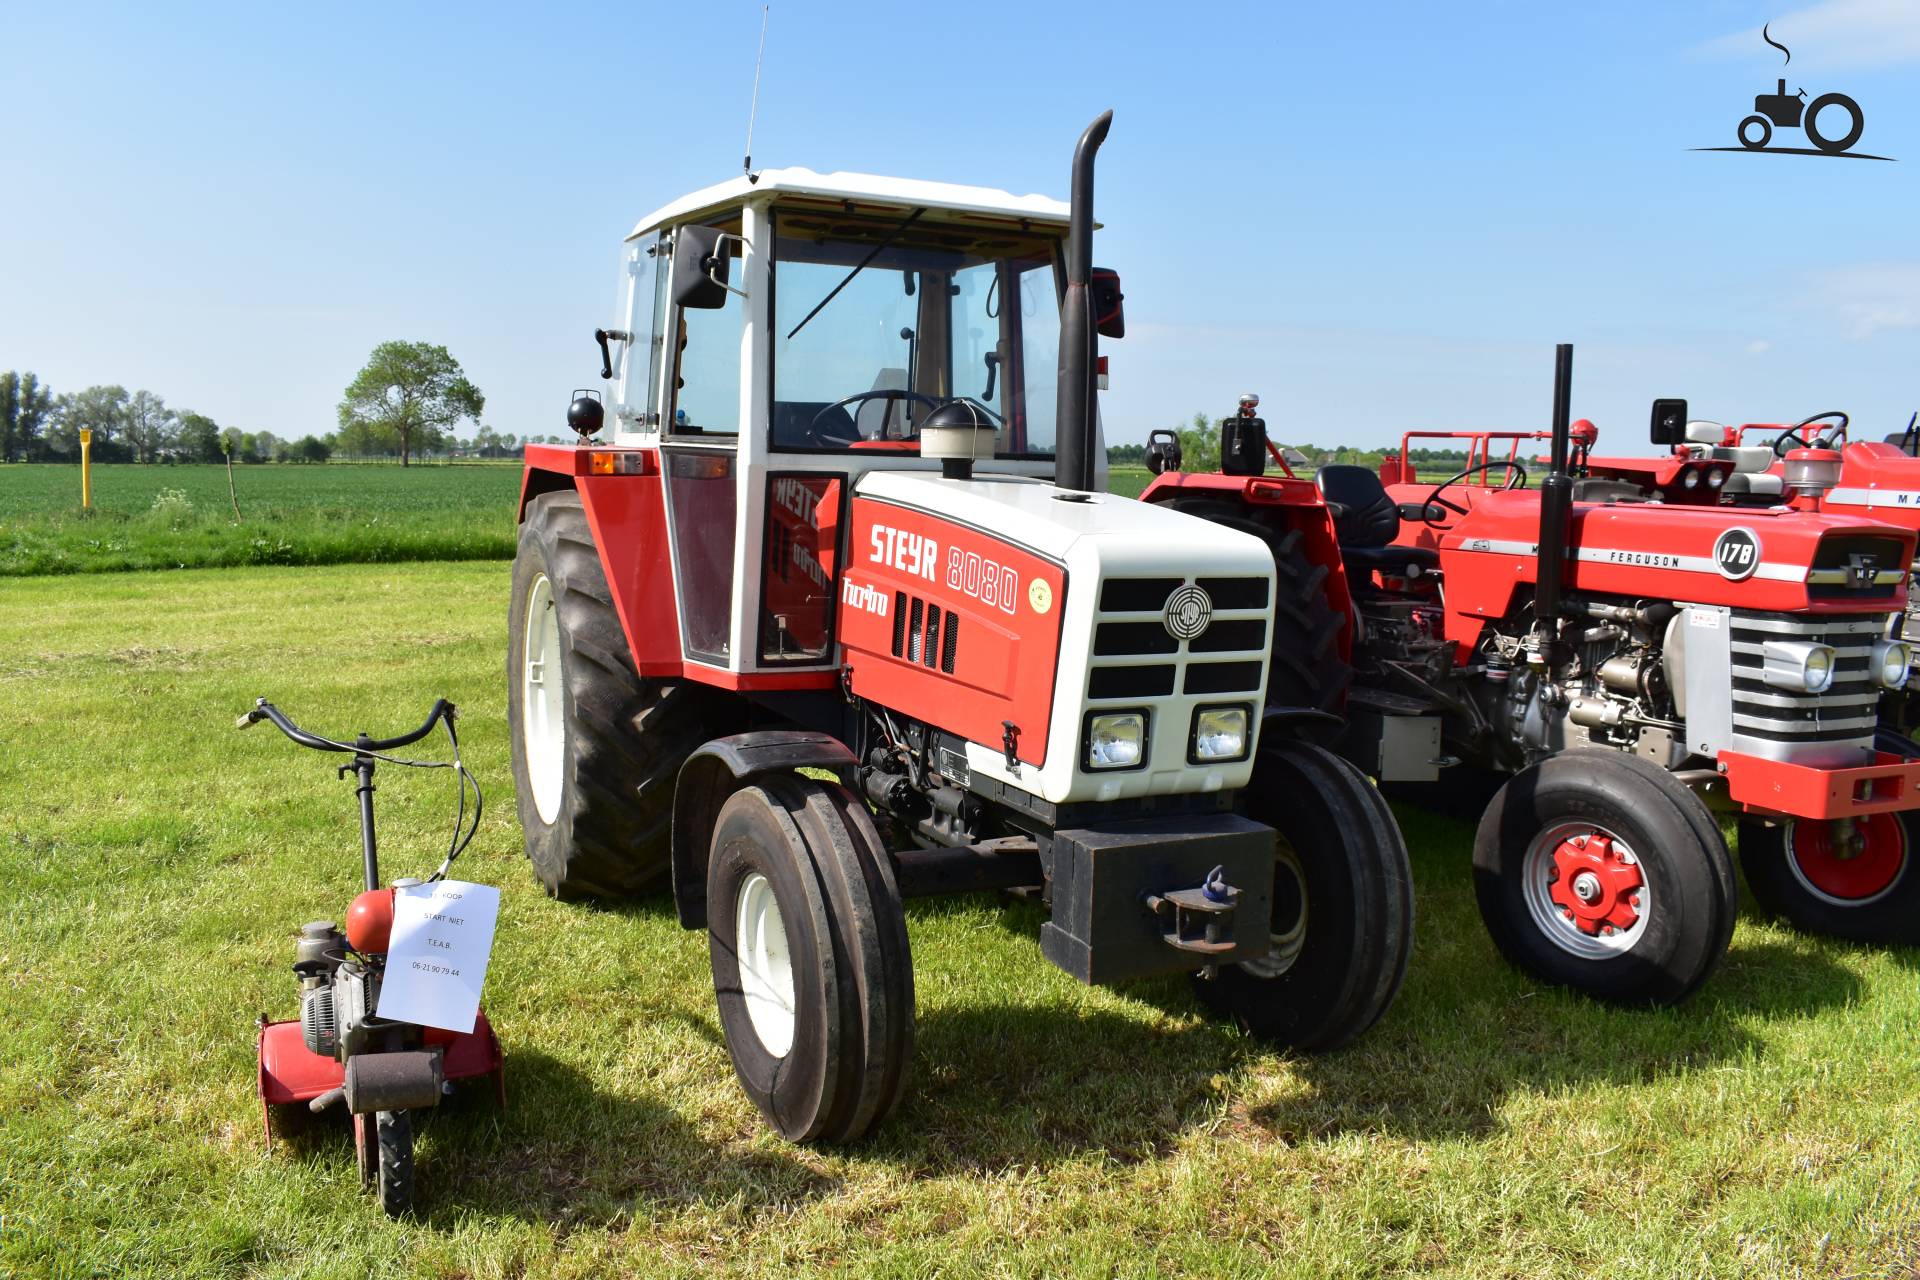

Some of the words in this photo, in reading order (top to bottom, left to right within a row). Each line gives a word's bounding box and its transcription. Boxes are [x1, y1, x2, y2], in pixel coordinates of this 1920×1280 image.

[1610, 551, 1679, 567] FERGUSON
[1721, 542, 1753, 564] 178
[870, 524, 937, 582] STEYR
[947, 545, 1018, 615] 8080
[842, 576, 888, 617] Turbo
[424, 912, 446, 922] START
[449, 916, 464, 926] NIET
[441, 967, 449, 975] 79
[451, 969, 460, 977] 44
